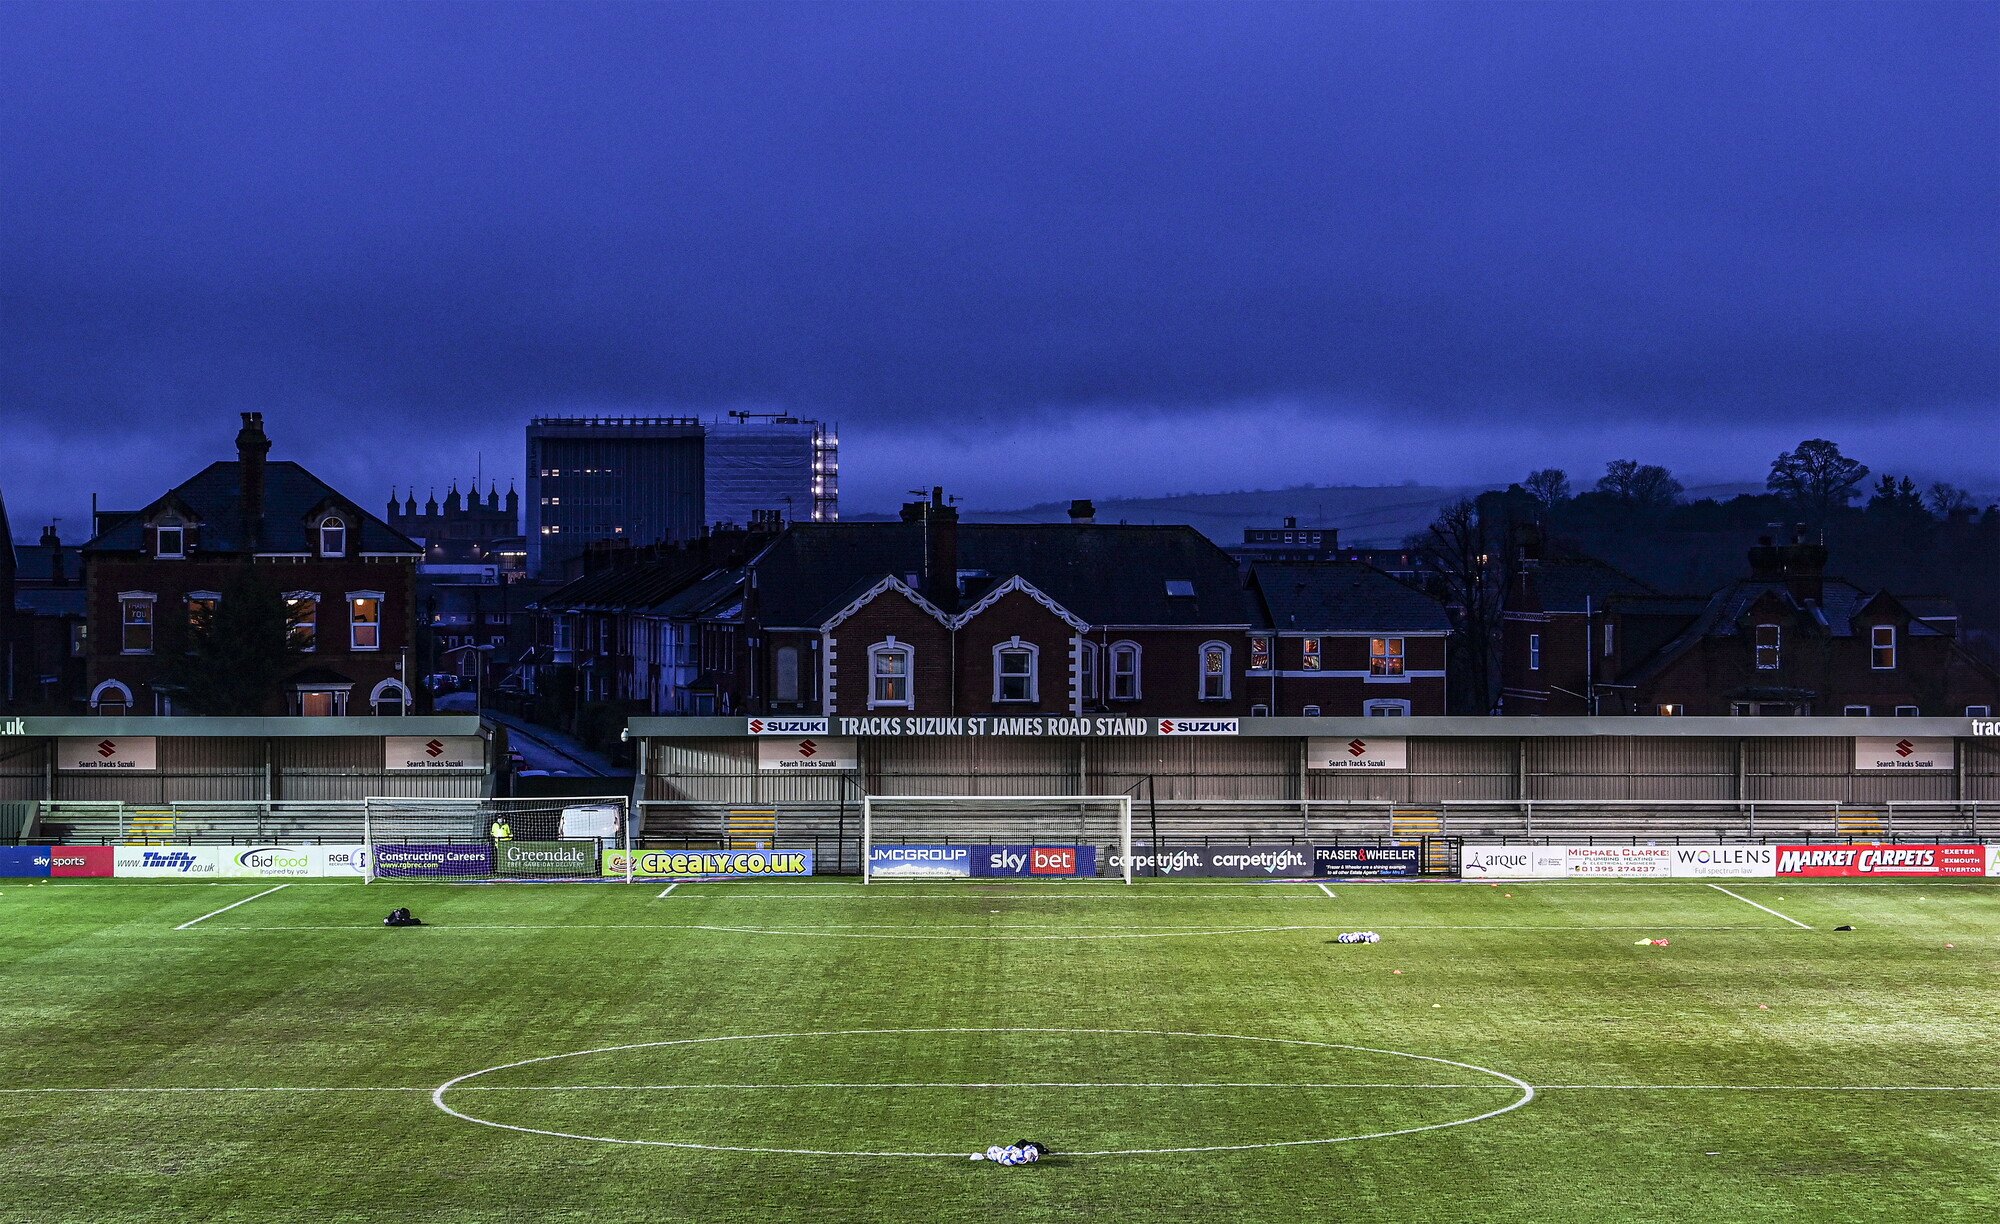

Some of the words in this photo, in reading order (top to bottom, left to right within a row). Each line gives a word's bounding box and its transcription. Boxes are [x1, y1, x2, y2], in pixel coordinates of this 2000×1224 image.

[132, 610, 147, 618] YOU
[0, 717, 25, 735] .uk
[767, 722, 826, 732] SUZUKI
[839, 718, 901, 736] TRACKS
[906, 718, 963, 736] SUZUKI
[968, 718, 986, 736] ST
[991, 718, 1042, 736] JAMES
[1048, 718, 1091, 736] ROAD
[1096, 718, 1147, 736] STAND
[1178, 722, 1236, 732] SUZUKI
[380, 852, 444, 862] Constructing
[447, 852, 485, 861] Careers
[507, 847, 584, 862] Greendale
[869, 849, 966, 861] JMCGROUP
[990, 848, 1027, 872] sky
[1035, 851, 1071, 868] bet
[1678, 850, 1770, 863] WOLLENS
[34, 856, 50, 867] sky
[53, 857, 85, 867] sports
[251, 855, 308, 867] Bidfood
[1486, 855, 1527, 869] arque
[1777, 850, 1857, 873] MARKET
[1858, 850, 1935, 872] CARPETS
